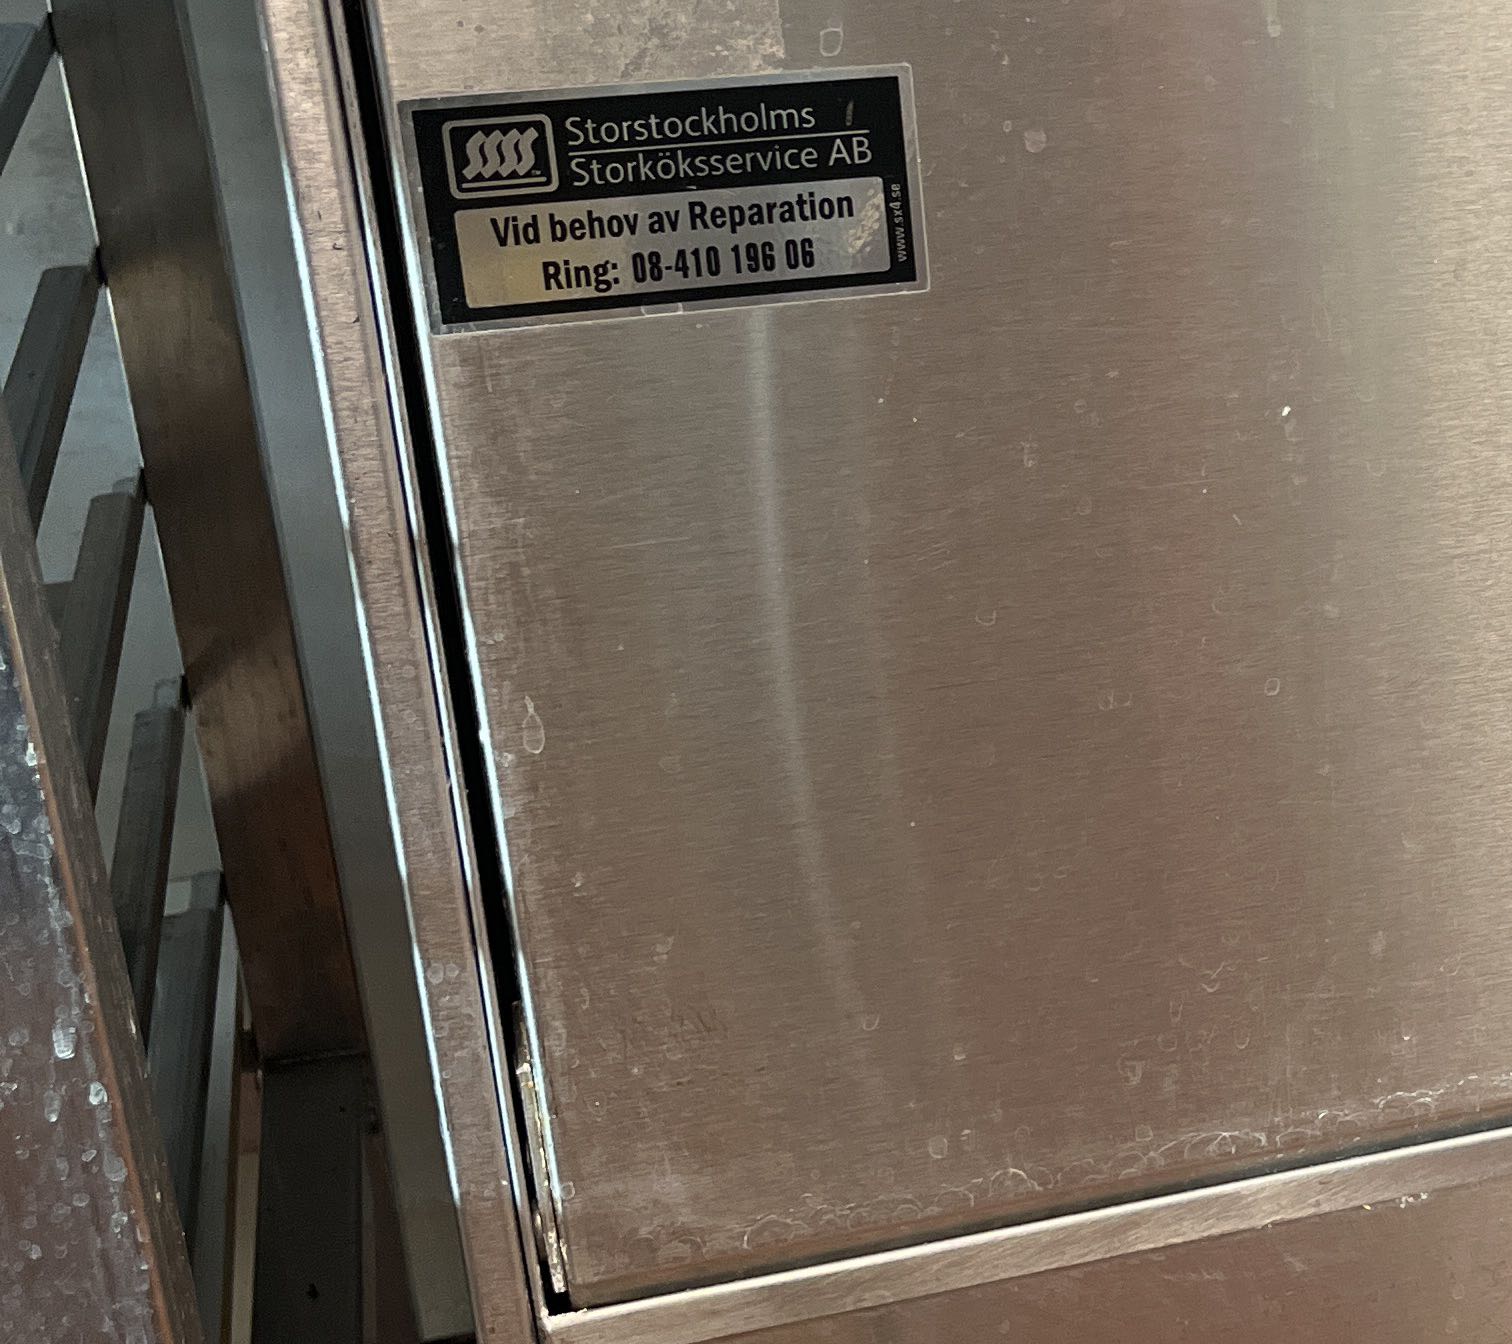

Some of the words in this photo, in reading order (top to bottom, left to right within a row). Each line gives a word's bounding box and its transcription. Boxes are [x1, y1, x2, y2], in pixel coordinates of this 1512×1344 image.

[564, 102, 816, 146] Storstockholms
[569, 145, 819, 187] Storköksservice
[828, 137, 873, 166] AB
[490, 214, 541, 248] Vid
[549, 207, 639, 244] behov
[648, 209, 681, 234] av
[689, 192, 855, 234] Reparation
[889, 183, 907, 262] www.sx4.se
[541, 258, 620, 294] Ring:
[631, 245, 721, 284] 08-410
[731, 240, 777, 275] 196
[785, 237, 816, 270] 06
